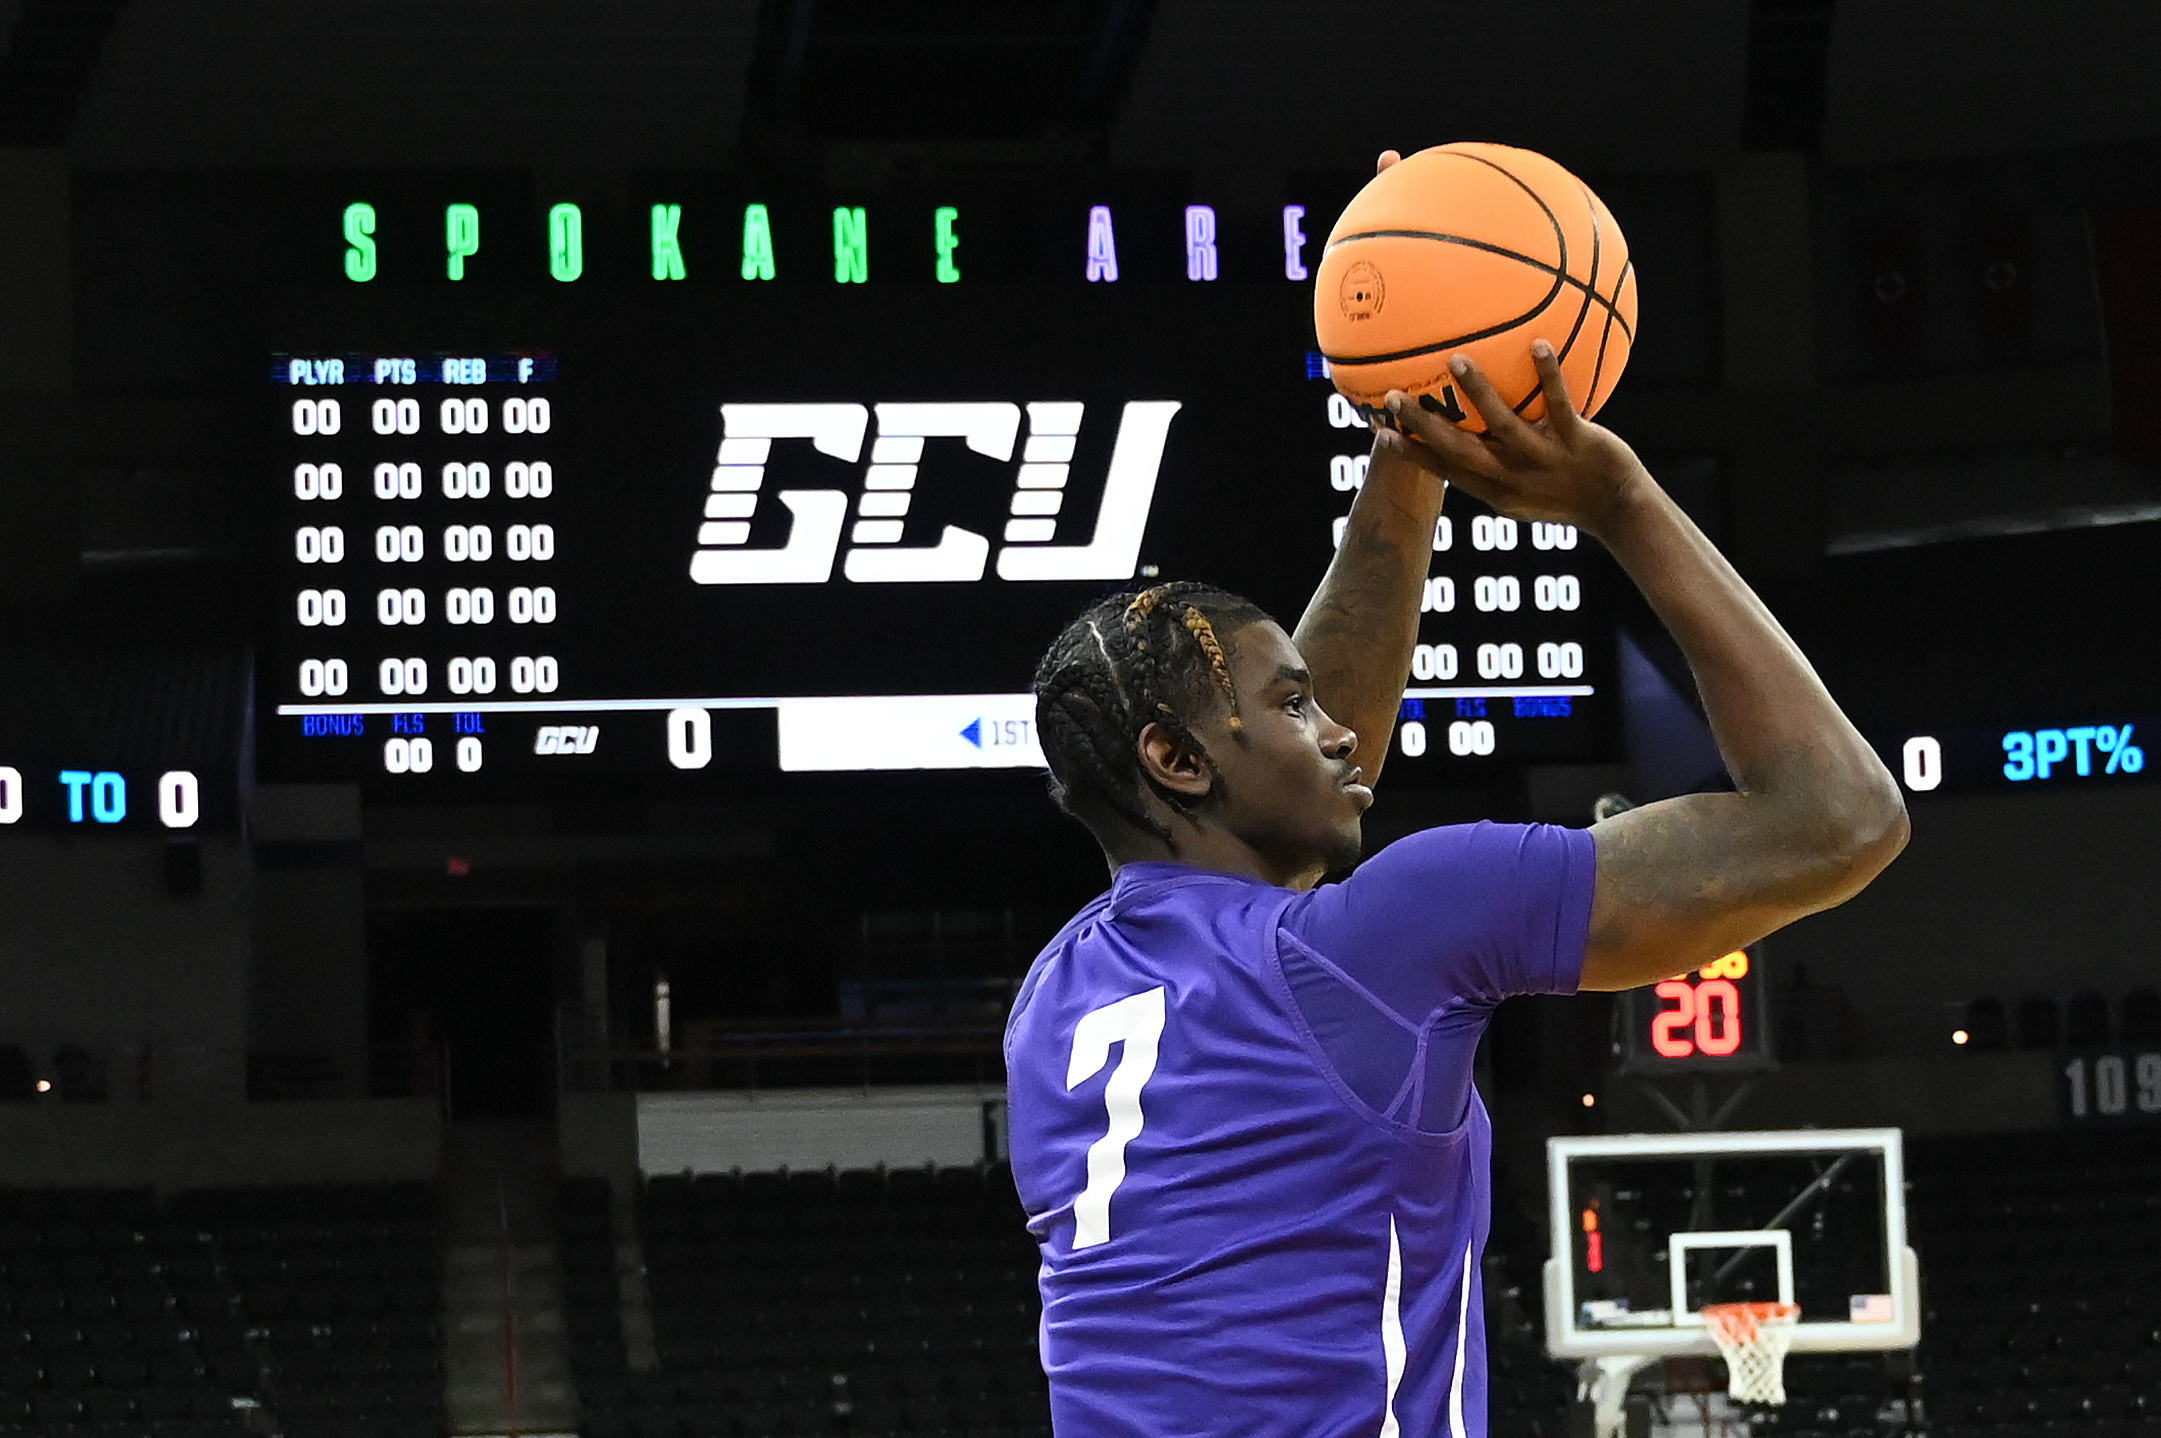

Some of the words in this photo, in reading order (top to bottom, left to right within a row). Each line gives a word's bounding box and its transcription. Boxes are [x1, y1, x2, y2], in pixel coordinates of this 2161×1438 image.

[343, 202, 961, 284] SPOKANE
[1086, 204, 1309, 282] ARE
[289, 358, 345, 385] PLYR
[374, 358, 417, 385] PTS
[442, 358, 487, 385] REB
[518, 358, 533, 384] F
[293, 399, 340, 435] 00
[372, 399, 420, 434] 00
[441, 398, 488, 434] 00
[503, 398, 550, 433] 00
[295, 463, 342, 500] 00
[374, 463, 422, 499] 00
[442, 462, 490, 498] 00
[505, 462, 552, 498] 00
[689, 400, 1182, 585] GCU
[296, 527, 344, 563] 00
[376, 526, 423, 562] 00
[444, 525, 492, 561] 00
[507, 524, 554, 560] 00
[1472, 515, 1518, 551] 00
[297, 589, 346, 626] 00
[377, 588, 425, 625] 00
[446, 588, 494, 624] 00
[509, 587, 556, 623] 00
[1474, 576, 1520, 612] 00
[1534, 575, 1580, 611] 00
[300, 659, 347, 696] 00
[379, 658, 427, 695] 00
[448, 657, 496, 694] 00
[511, 656, 558, 693] 00
[1412, 644, 1458, 680] 00
[1477, 643, 1523, 679] 00
[1537, 642, 1583, 678] 00
[303, 714, 364, 736] BONUS
[393, 714, 425, 733] FLS
[535, 726, 600, 754] GCU
[667, 708, 712, 769] 0
[993, 720, 1029, 746] 1ST
[1401, 721, 1426, 757] 0
[1449, 720, 1495, 756] 00
[385, 737, 433, 773] 00
[457, 737, 482, 772] 0
[1903, 736, 1942, 791] 0
[2002, 723, 2144, 782] 3PT%
[59, 770, 127, 824] TO
[159, 771, 199, 828] 0
[1652, 980, 1742, 1058] 20
[2065, 1053, 2161, 1116] 109
[1067, 986, 1165, 1250] 7
